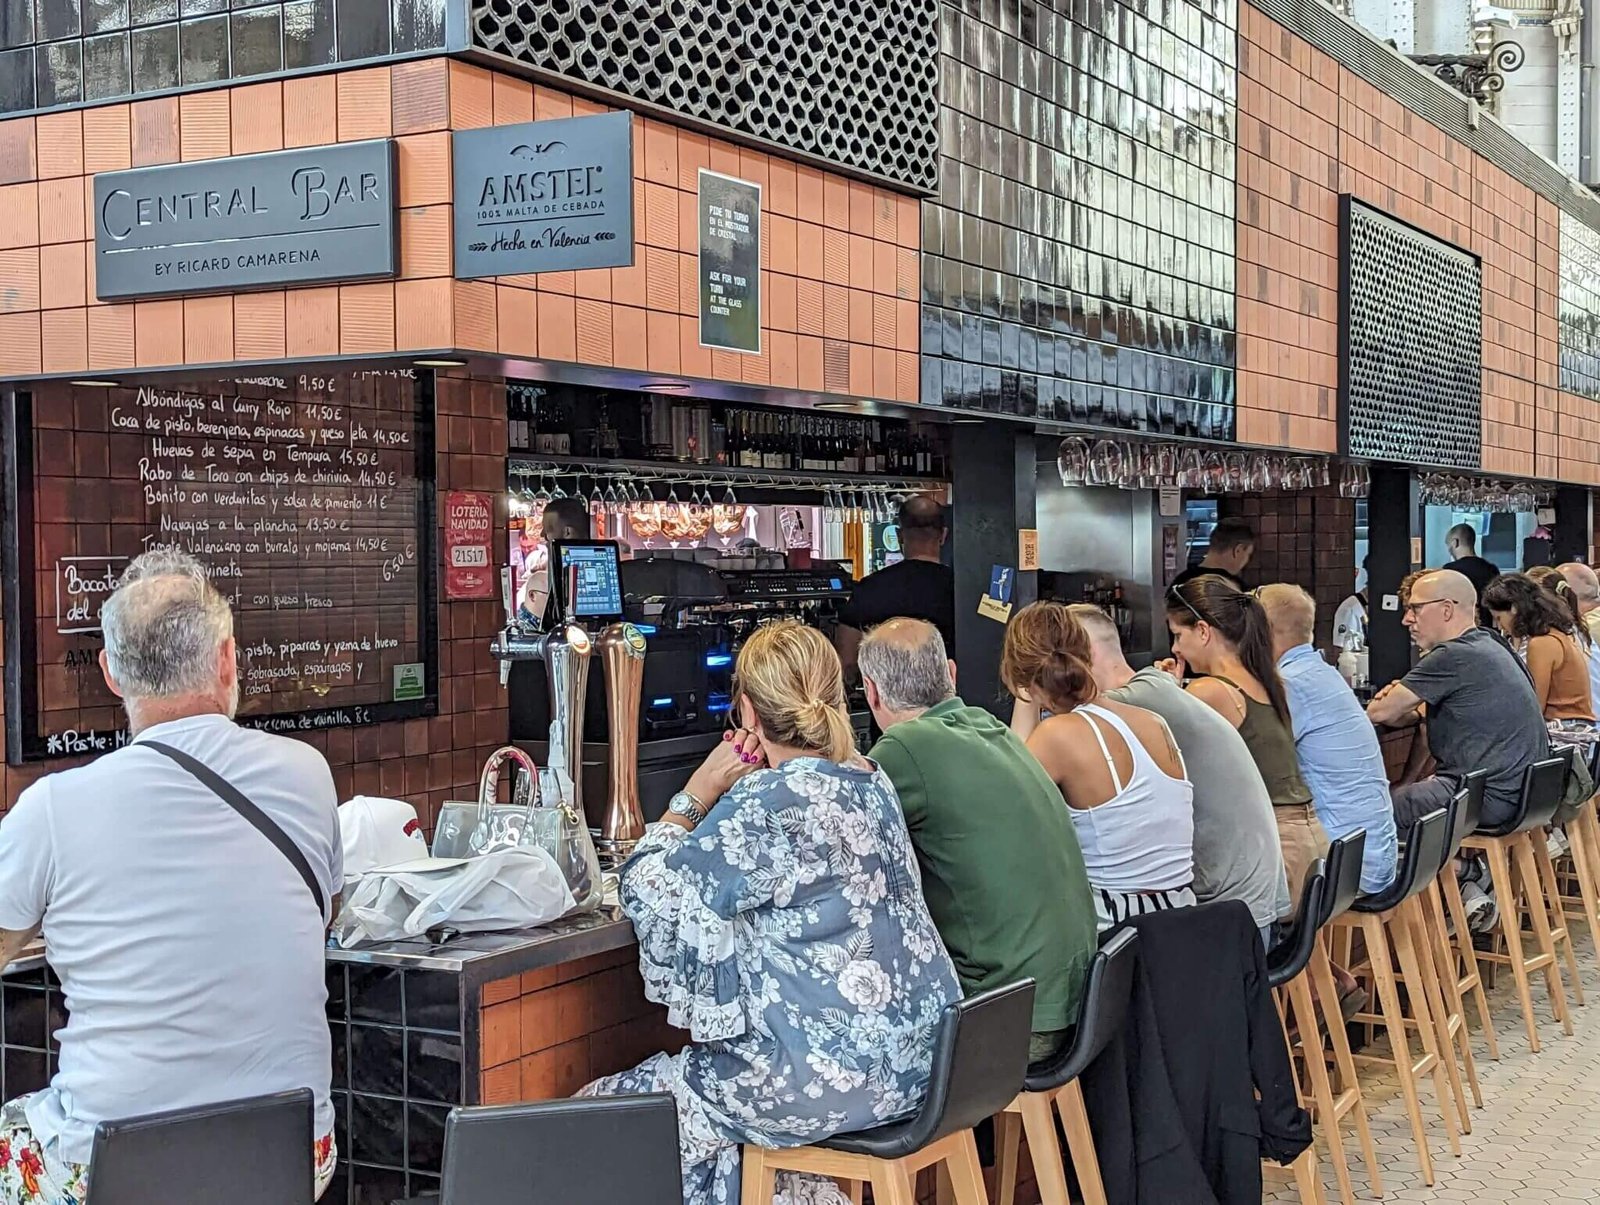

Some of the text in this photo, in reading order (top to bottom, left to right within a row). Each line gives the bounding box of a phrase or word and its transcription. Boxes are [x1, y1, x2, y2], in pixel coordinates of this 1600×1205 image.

[479, 166, 603, 207] AMSTEL
[477, 200, 605, 219] 100% MALTA DE CEBADA
[709, 204, 749, 223] PIDE TU TURNO
[709, 216, 749, 233] EN EL MOSTRADOR
[709, 226, 736, 240] DE CRISTAL
[490, 226, 590, 251] Hecha en Valencia
[155, 249, 321, 276] BY RICARD CAMARENA
[709, 271, 746, 287] ASK FOR YOUR
[710, 283, 723, 294] TURN
[710, 295, 742, 308] AT THE GLASS
[710, 305, 730, 316] COUNTER
[211, 394, 224, 412] al
[233, 396, 259, 421] Curry
[266, 399, 291, 421] Rojo
[111, 407, 139, 428] Coca
[145, 413, 160, 429] de
[164, 415, 194, 436] pisto,
[196, 416, 251, 440] berenjena,
[253, 422, 305, 444] espinacas
[310, 428, 317, 448] y
[320, 428, 345, 446] queso
[350, 420, 368, 449] feta
[152, 437, 194, 457] Huevas
[201, 441, 215, 458] de
[223, 441, 255, 465] sepia
[262, 448, 276, 461] en
[286, 444, 331, 468] Tempura
[138, 457, 172, 481] Rabo
[181, 463, 196, 480] de
[205, 463, 229, 482] Toro
[234, 471, 253, 483] con
[260, 466, 289, 489] chips
[294, 467, 307, 483] de
[144, 484, 186, 505] Bonito
[191, 491, 208, 504] con
[214, 488, 266, 506] verduritas
[271, 498, 279, 515] y
[283, 491, 307, 508] salsa
[310, 493, 321, 508] de
[324, 492, 362, 512] pimiento
[160, 513, 210, 537] Navajas
[218, 520, 227, 530] a
[234, 515, 246, 531] la
[253, 517, 298, 537] plancha
[451, 518, 489, 530] NAVIDAD
[186, 537, 242, 554] Valenciano
[245, 543, 260, 553] con
[264, 537, 298, 554] burrata
[305, 543, 311, 561] y
[315, 538, 352, 560] mojama
[455, 550, 483, 563] 21517
[66, 597, 91, 622] del
[253, 595, 269, 605] con
[273, 595, 299, 612] queso
[304, 592, 333, 613] fresco
[244, 637, 276, 661] pisto,
[279, 638, 321, 661] piparras
[324, 642, 331, 657] y
[333, 640, 359, 657] yema
[360, 635, 371, 651] de
[374, 631, 398, 650] huevo
[247, 661, 300, 680] sobrasada,
[357, 661, 364, 680] y
[245, 681, 271, 696] cabra
[298, 714, 311, 730] de
[313, 709, 352, 727] vainilla
